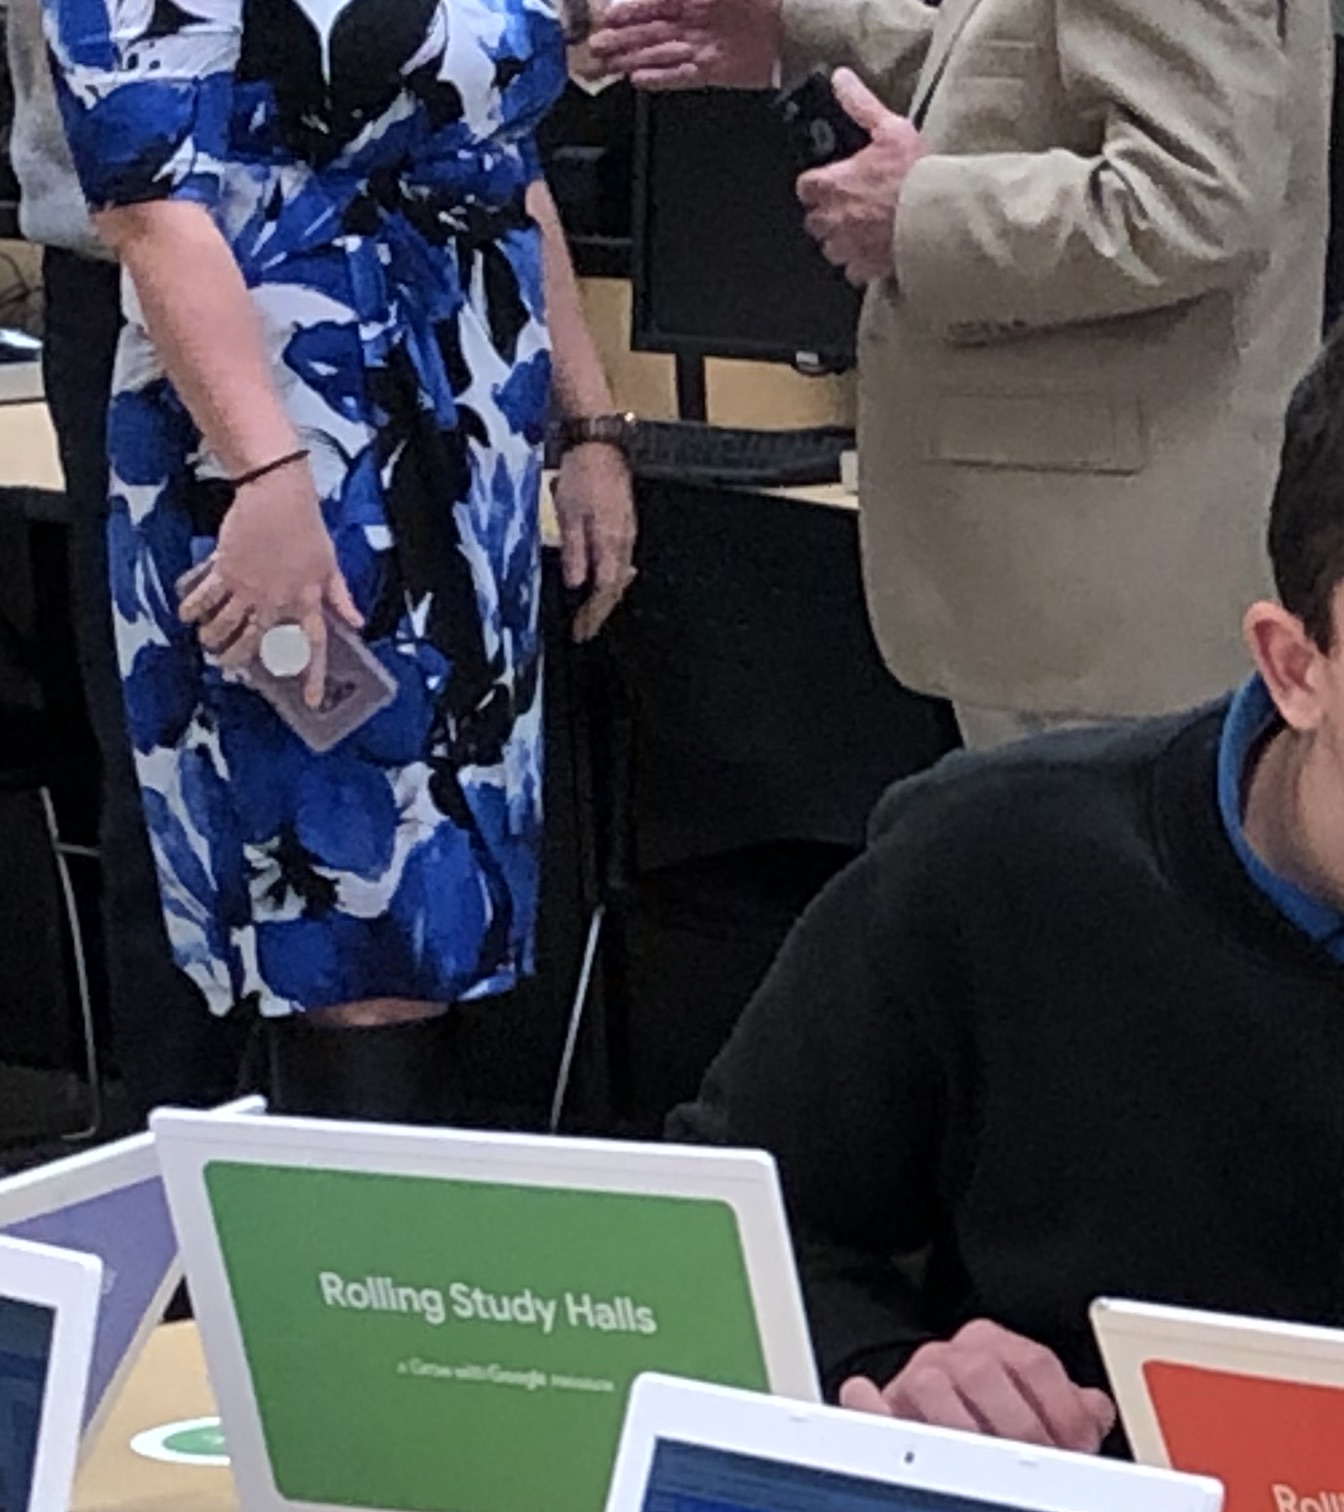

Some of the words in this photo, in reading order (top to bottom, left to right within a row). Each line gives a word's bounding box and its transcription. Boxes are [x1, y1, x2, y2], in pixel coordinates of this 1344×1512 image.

[319, 1271, 446, 1325] Rolling
[449, 1282, 556, 1334] Study
[565, 1292, 657, 1334] Halls
